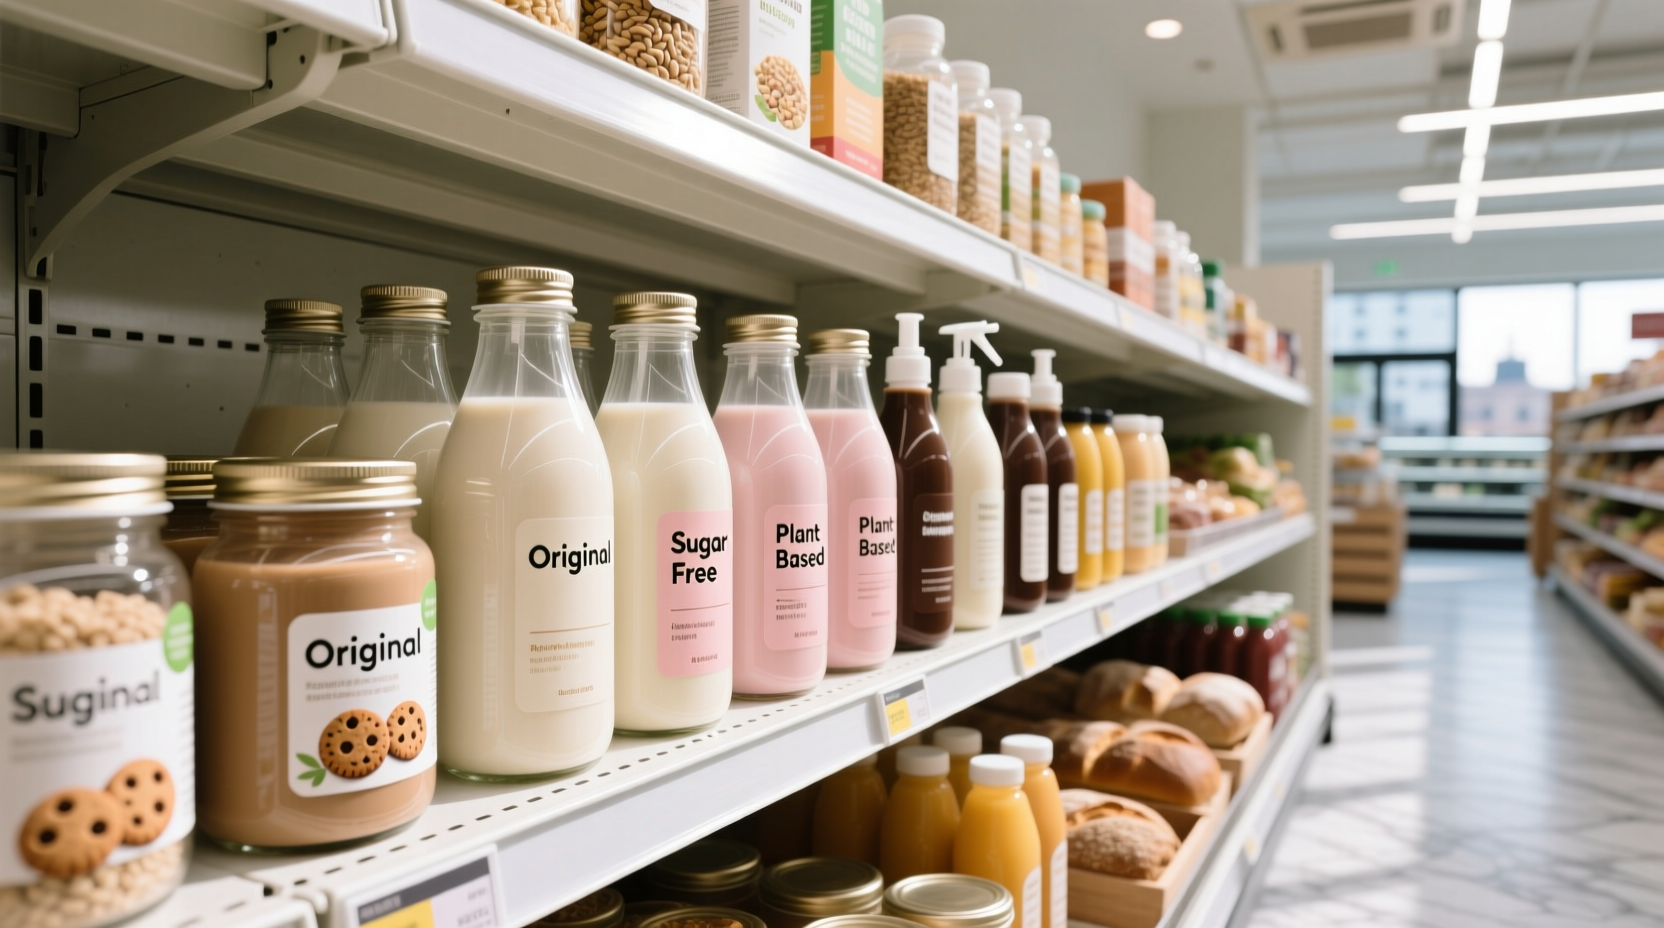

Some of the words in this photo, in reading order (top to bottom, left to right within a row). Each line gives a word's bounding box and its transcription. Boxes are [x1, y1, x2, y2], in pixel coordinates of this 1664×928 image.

[776, 523, 821, 543] Plant
[859, 516, 894, 533] Plant
[671, 531, 728, 559] Sugar
[776, 546, 825, 569] Based
[528, 540, 612, 576] Original
[672, 562, 718, 584] Free
[305, 627, 421, 671] Original
[11, 671, 159, 727] Suginal
